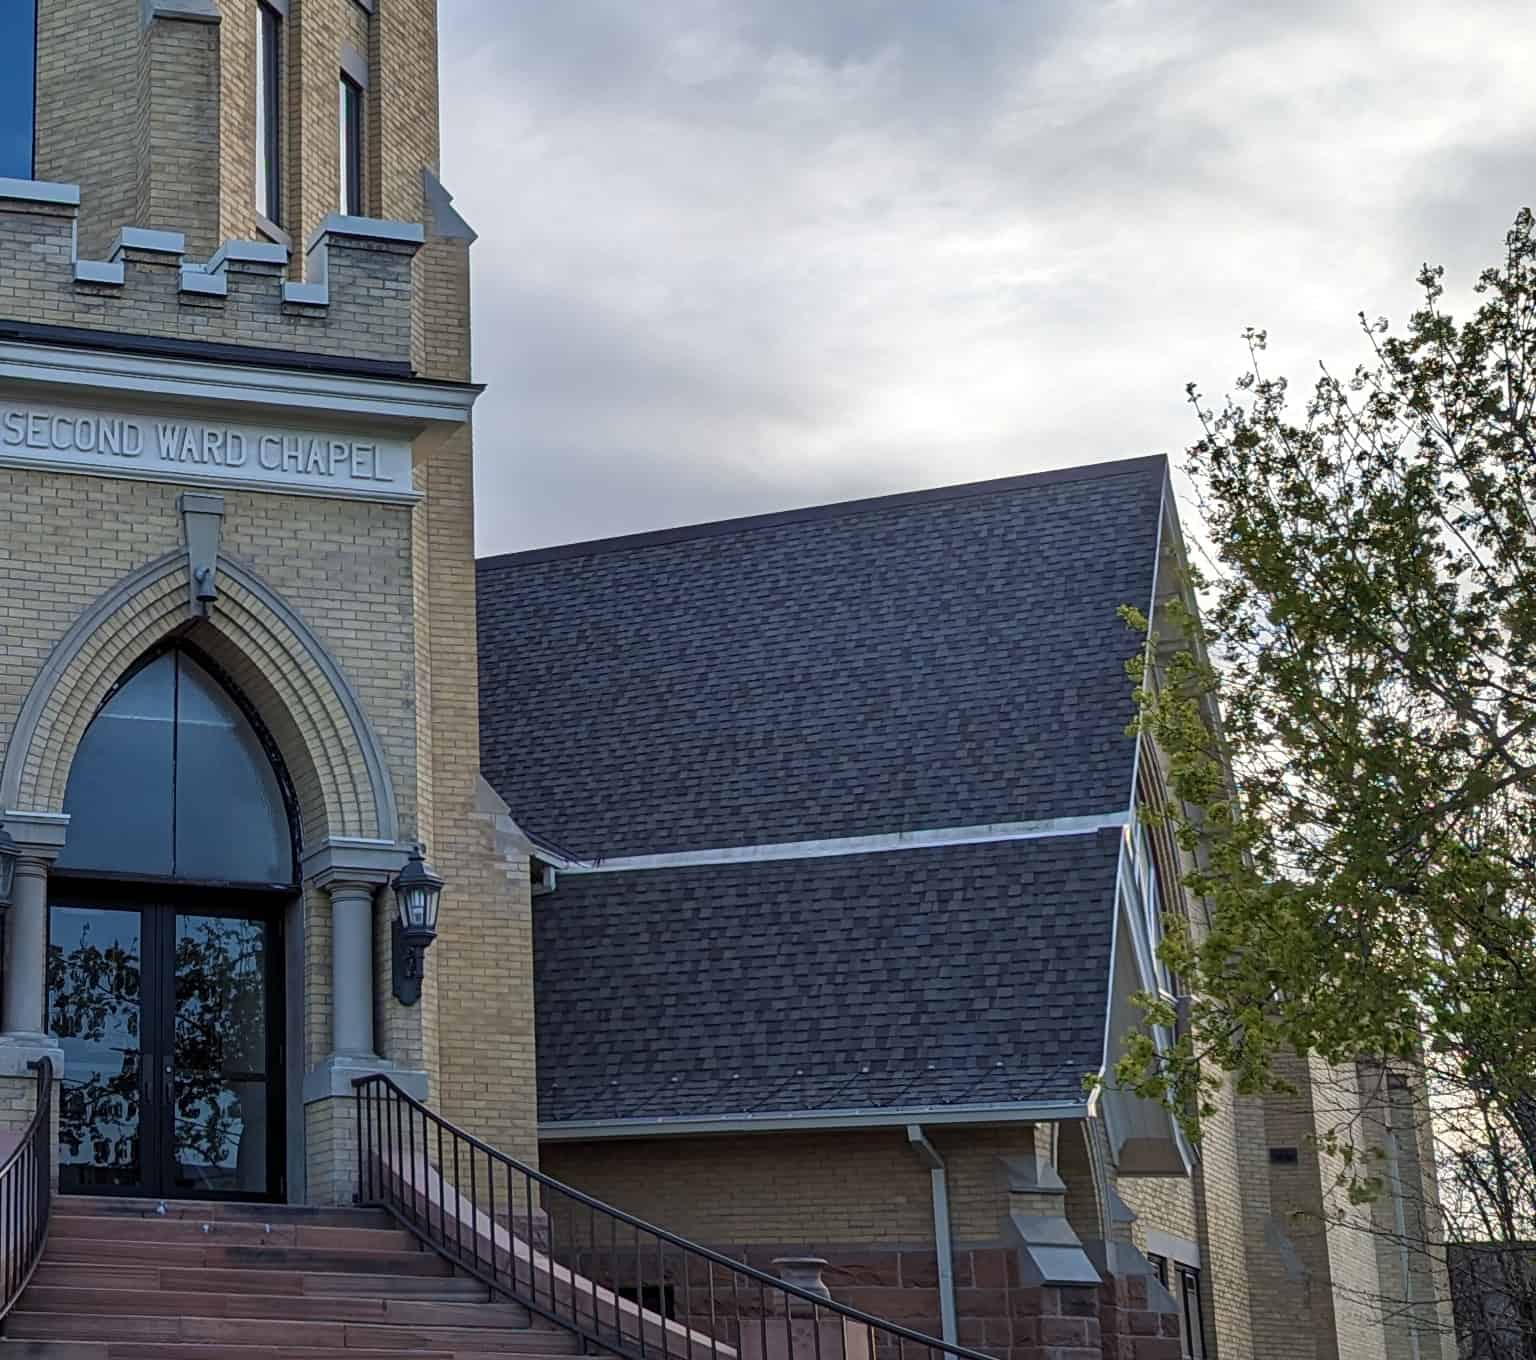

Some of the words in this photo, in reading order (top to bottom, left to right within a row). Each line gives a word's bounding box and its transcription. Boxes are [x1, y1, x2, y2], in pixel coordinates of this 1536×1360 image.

[2, 409, 144, 457] SECOND
[155, 422, 248, 468] WARD
[258, 434, 395, 483] CHAPEL
